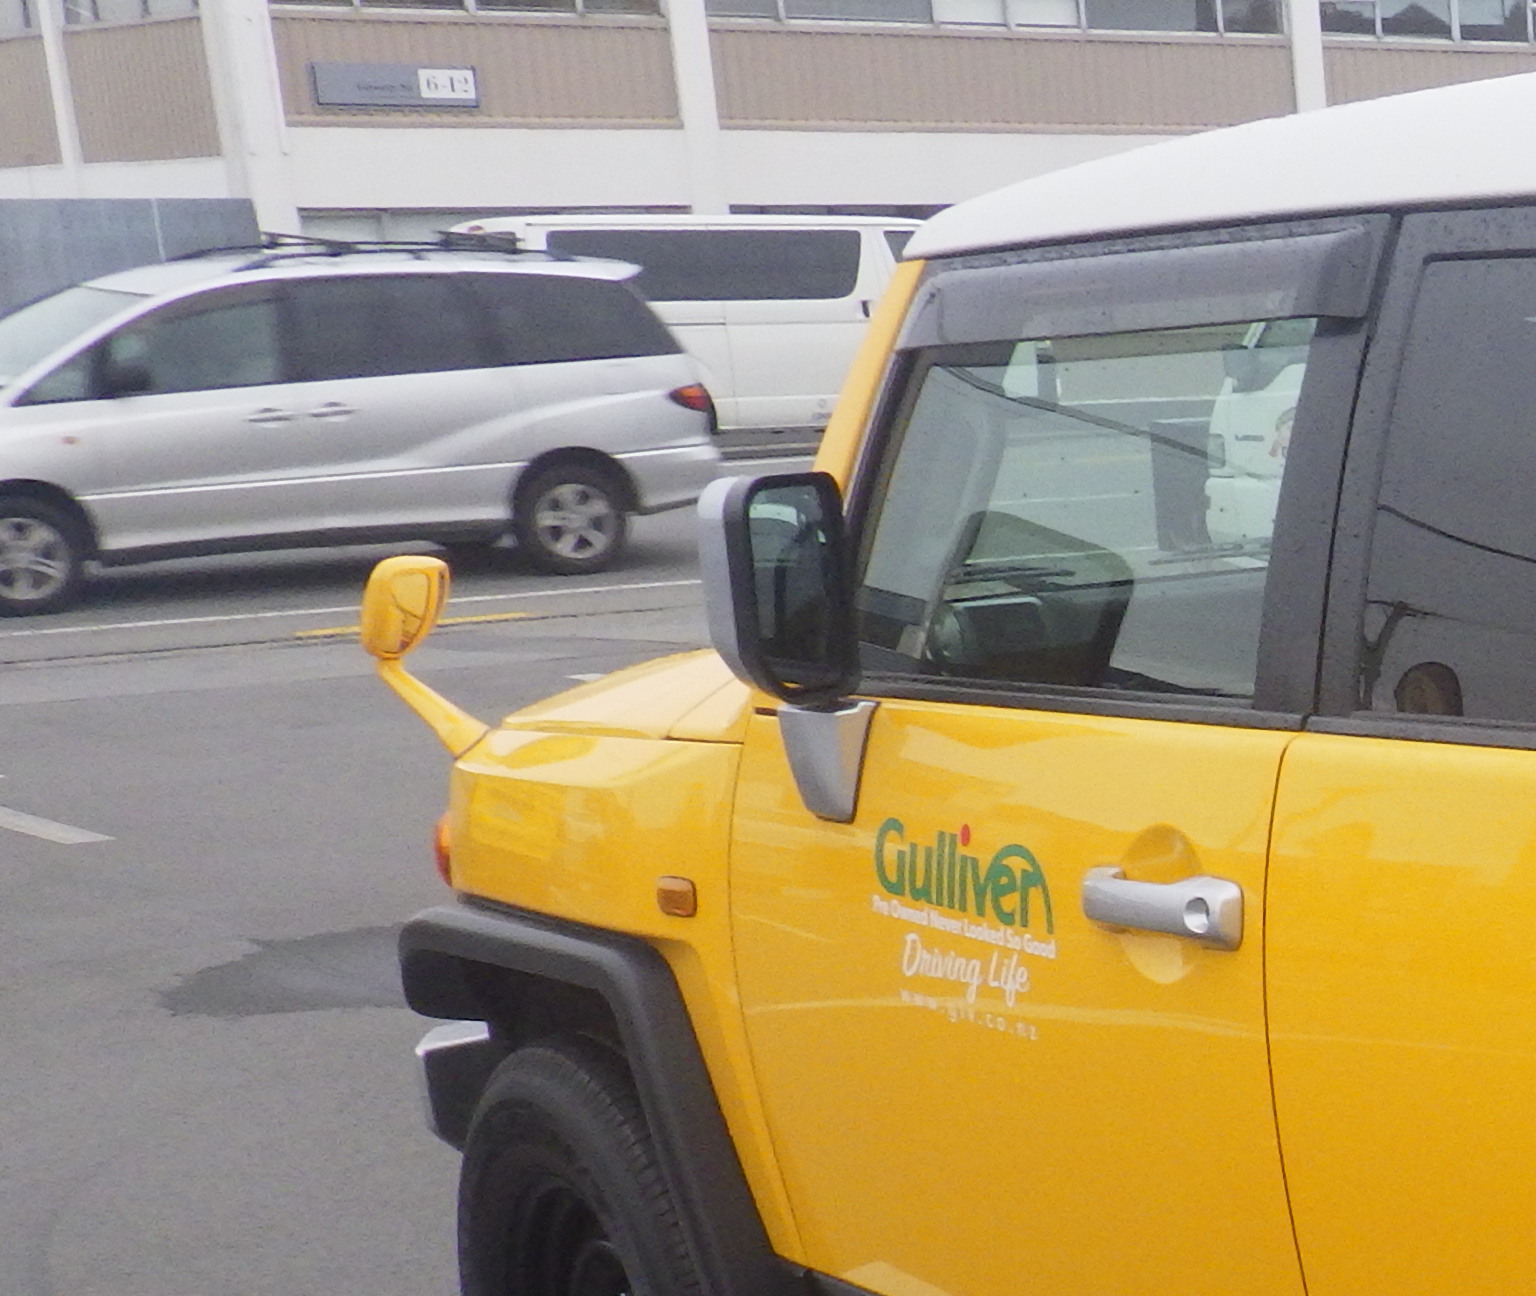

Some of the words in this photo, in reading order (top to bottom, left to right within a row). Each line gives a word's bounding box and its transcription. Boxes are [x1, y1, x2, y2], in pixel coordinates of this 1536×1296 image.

[875, 817, 1054, 935] Gulliver
[902, 932, 981, 1003] Driving
[988, 949, 1031, 1007] Life
